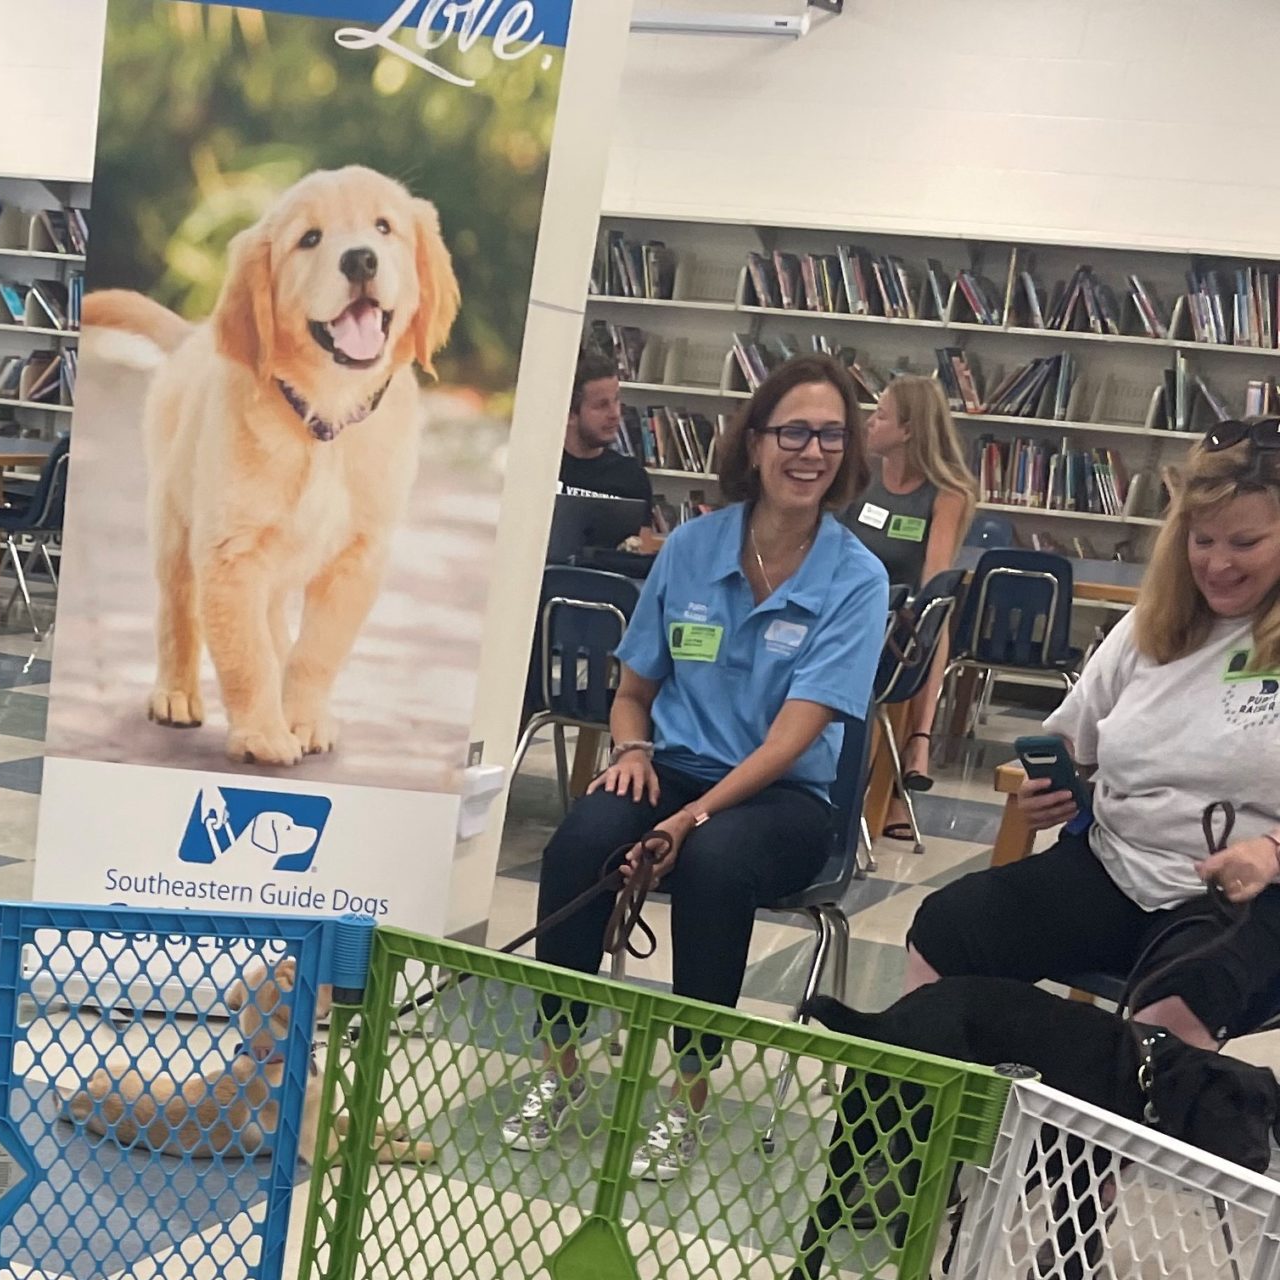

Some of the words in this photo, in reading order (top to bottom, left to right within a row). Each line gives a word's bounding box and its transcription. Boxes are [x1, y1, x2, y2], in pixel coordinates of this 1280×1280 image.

[104, 867, 253, 902] Southeastern
[259, 882, 326, 910] Guide
[332, 889, 389, 918] Dogs
